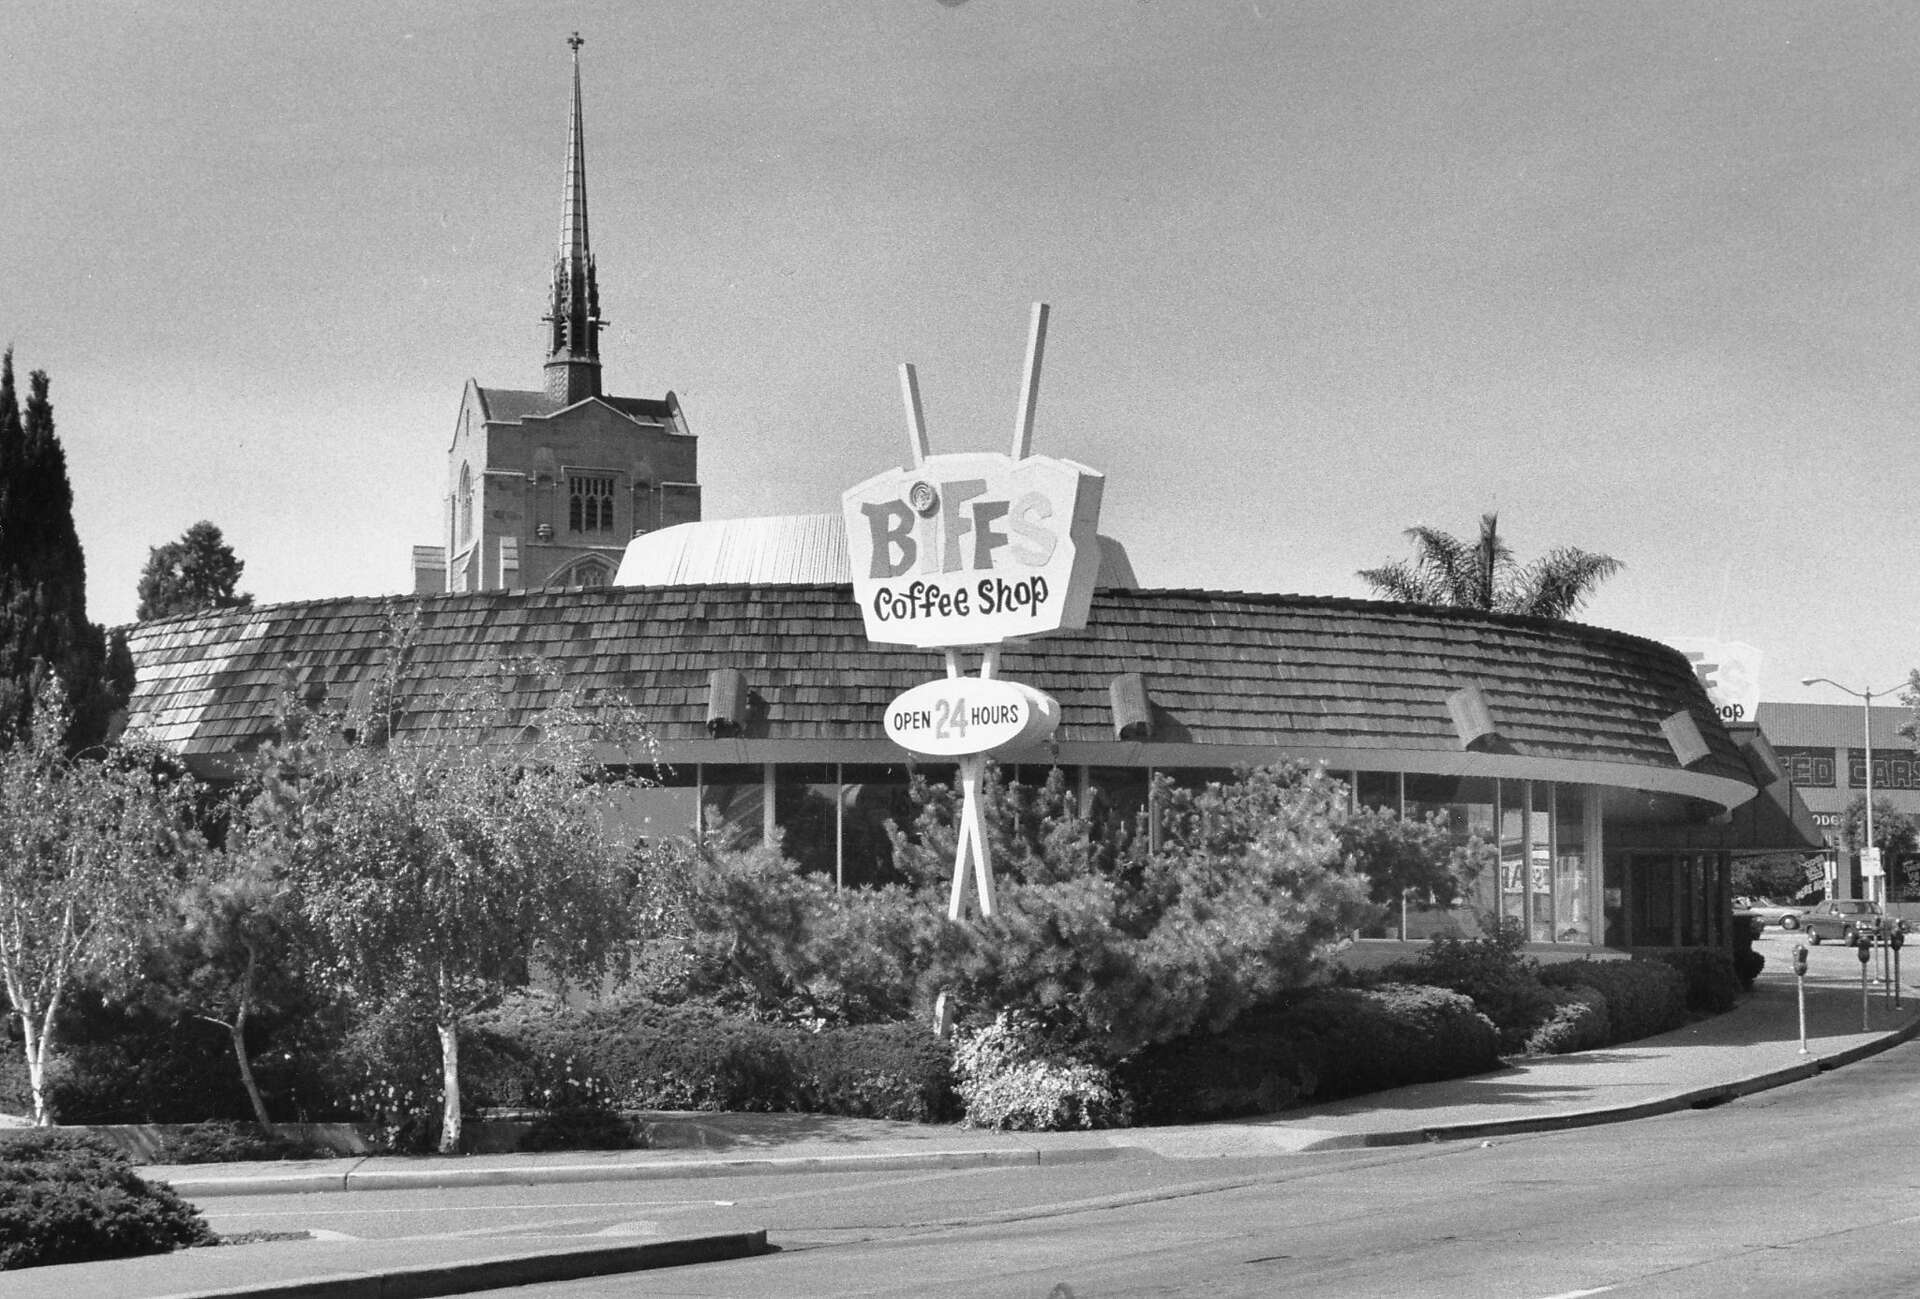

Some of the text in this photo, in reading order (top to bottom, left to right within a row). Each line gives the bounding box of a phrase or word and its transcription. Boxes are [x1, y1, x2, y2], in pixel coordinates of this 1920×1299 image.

[873, 575, 1049, 622] Coffee Shop
[894, 698, 1019, 740] OPEN 24 HOURS
